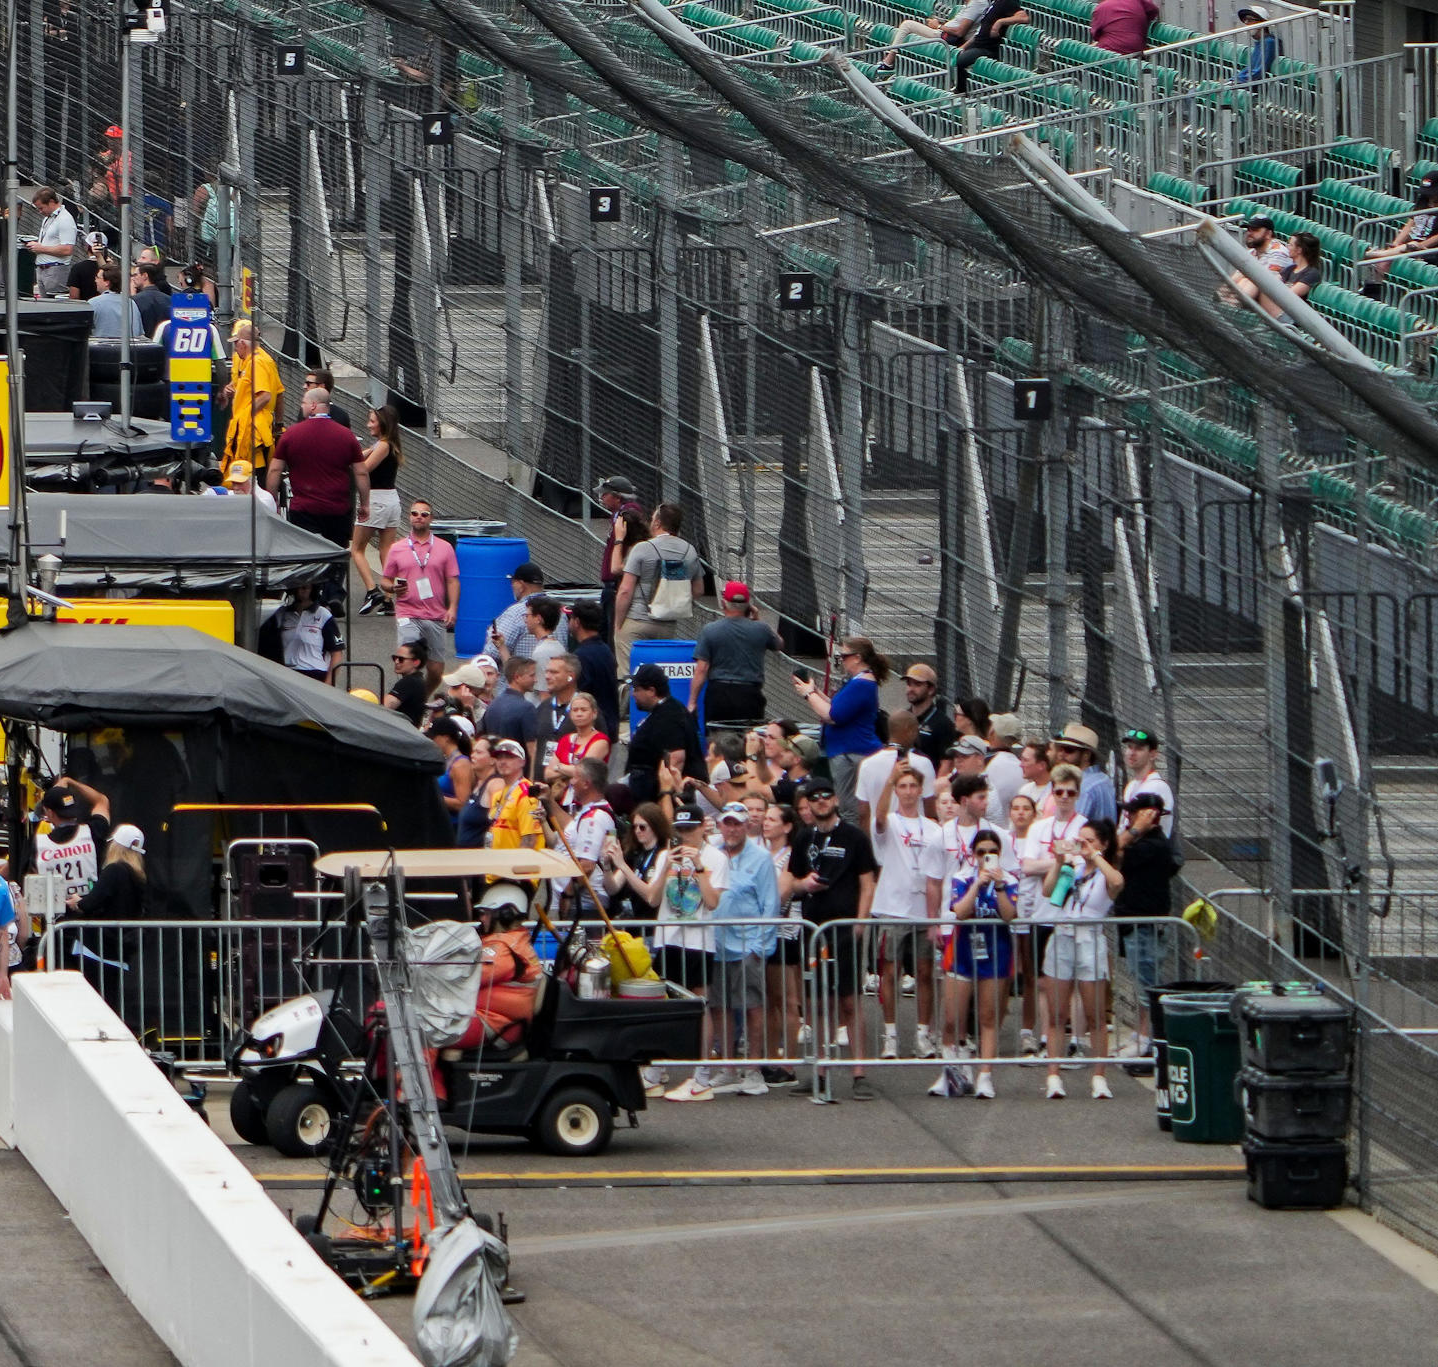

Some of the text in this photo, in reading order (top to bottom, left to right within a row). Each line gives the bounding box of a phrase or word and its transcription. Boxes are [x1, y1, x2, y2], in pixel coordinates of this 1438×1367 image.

[284, 52, 296, 67] 5
[430, 121, 442, 136] 4
[598, 196, 611, 212] 3
[789, 282, 803, 299] 2
[173, 327, 208, 353] 60
[1027, 390, 1036, 408] 1
[41, 843, 92, 862] Canon
